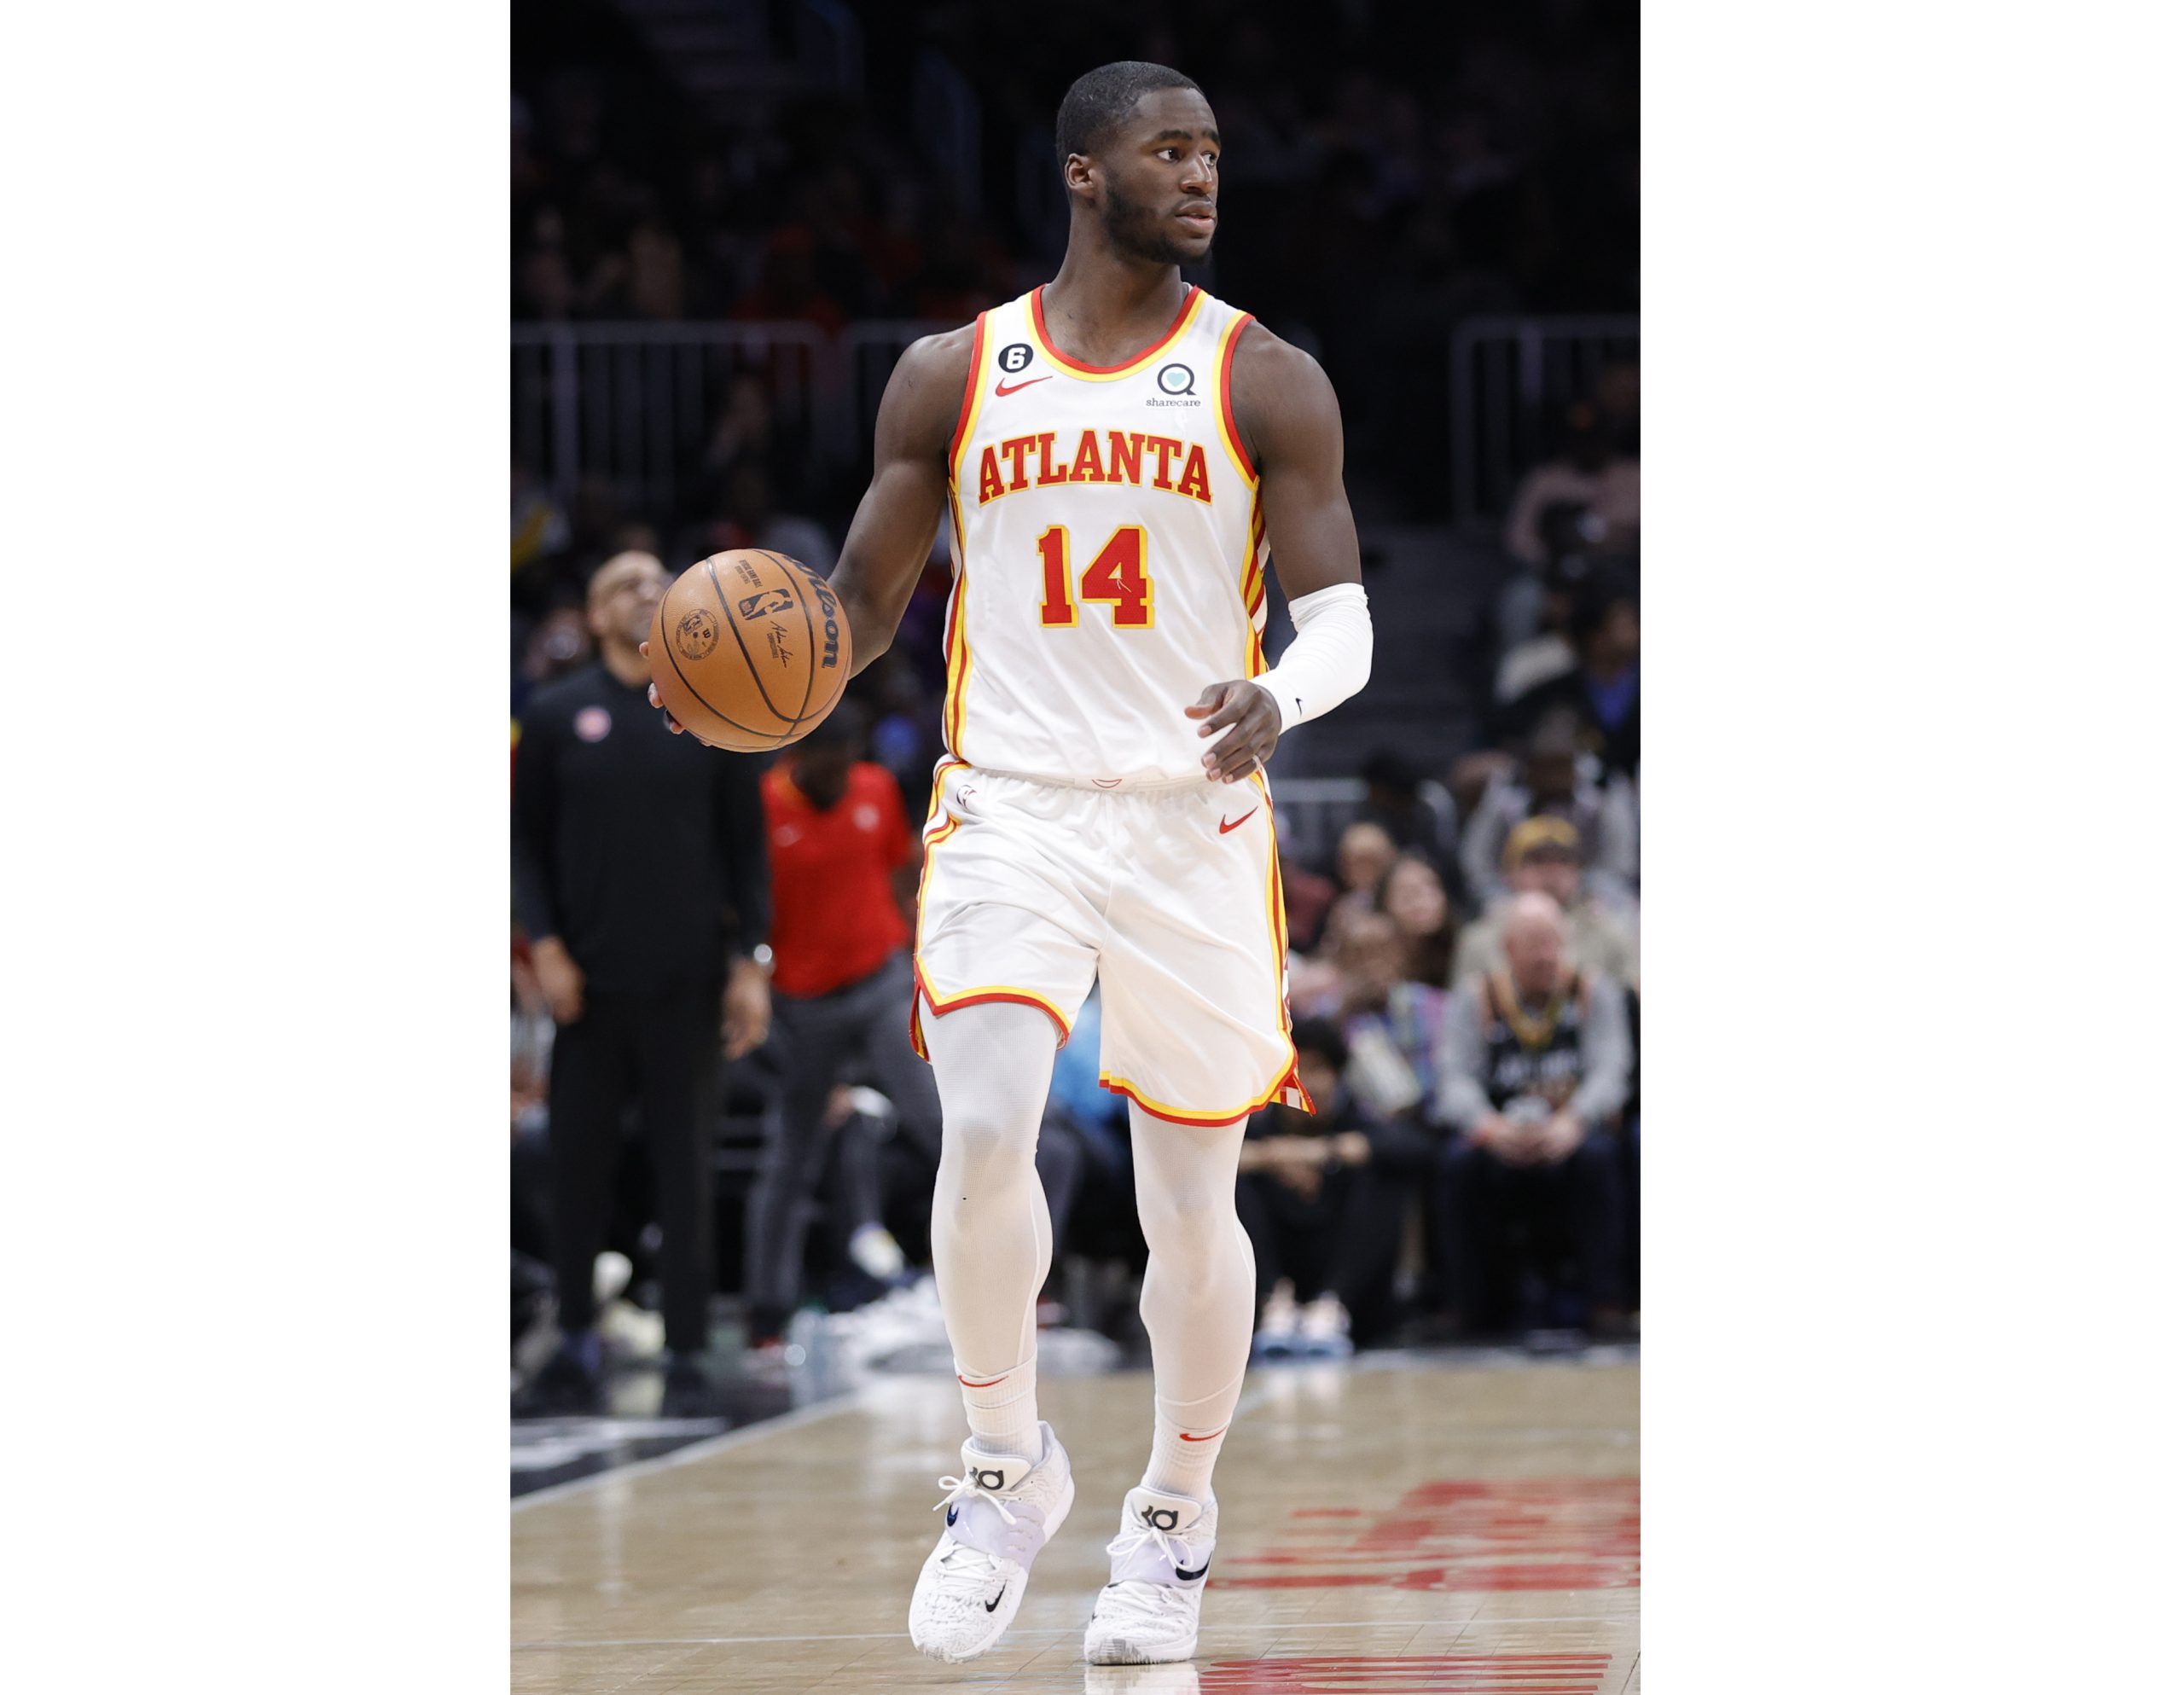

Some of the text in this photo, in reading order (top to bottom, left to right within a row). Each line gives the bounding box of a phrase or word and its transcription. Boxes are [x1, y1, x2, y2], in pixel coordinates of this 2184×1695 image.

[1006, 346, 1026, 370] 6
[1146, 398, 1201, 407] sharecare
[979, 428, 1212, 507] ATLANTA
[1037, 525, 1154, 629] 14
